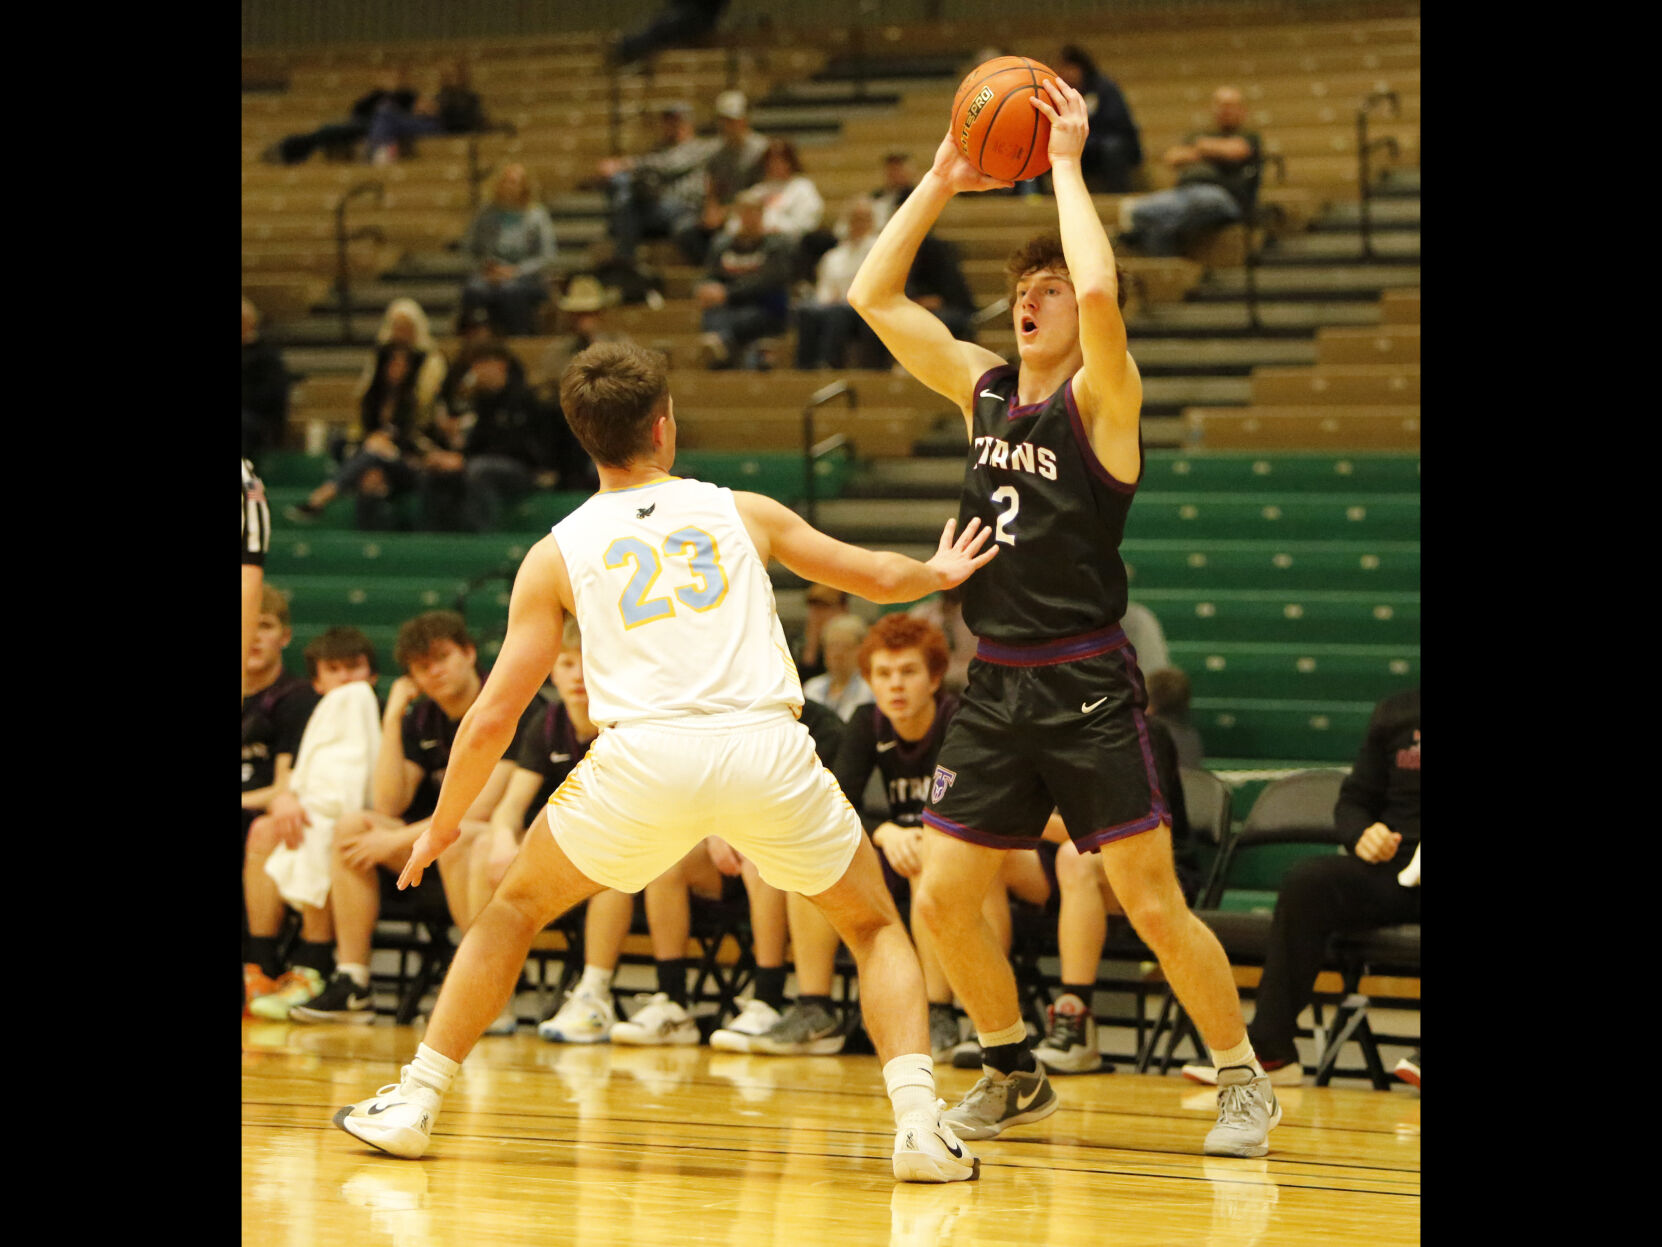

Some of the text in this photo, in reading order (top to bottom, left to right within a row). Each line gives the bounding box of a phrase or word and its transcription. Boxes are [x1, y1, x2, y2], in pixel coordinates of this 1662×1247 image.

[973, 435, 1058, 481] TANS
[991, 485, 1020, 546] 2
[602, 525, 729, 631] 23
